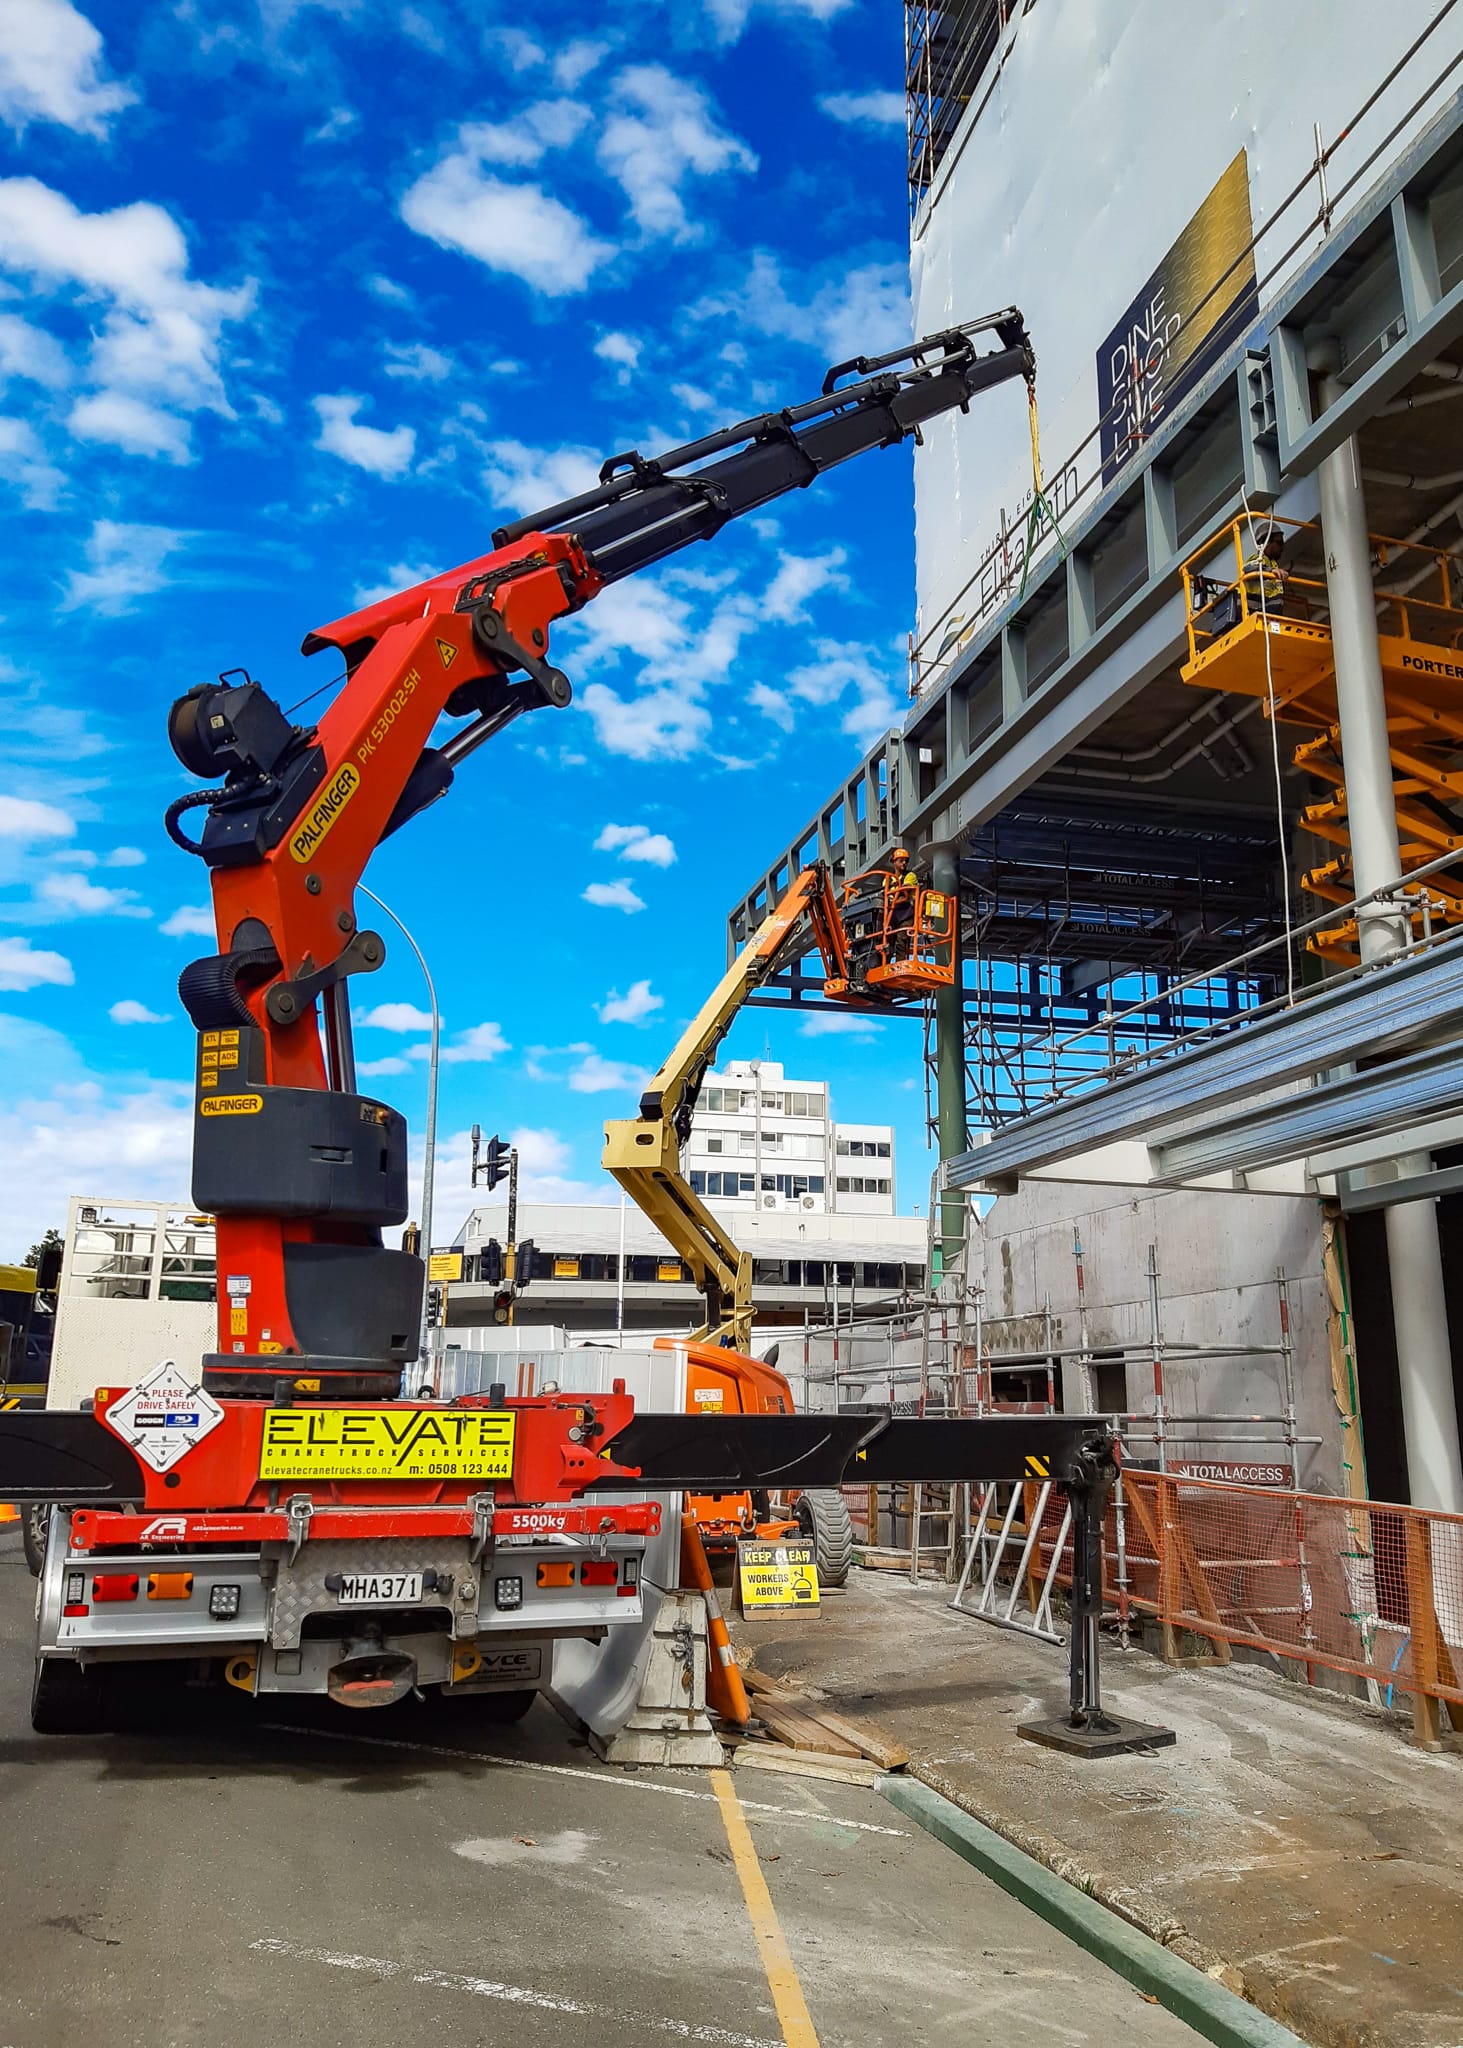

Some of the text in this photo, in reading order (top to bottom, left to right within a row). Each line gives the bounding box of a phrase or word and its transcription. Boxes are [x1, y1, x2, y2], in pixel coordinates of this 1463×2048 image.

[1111, 286, 1166, 388] DINE
[980, 514, 1013, 566] THIRY
[357, 667, 422, 764] PK 53002-SH
[293, 768, 357, 858] PALFINGER
[203, 1098, 258, 1113] PALFINGER
[151, 1389, 184, 1398] PLEASE
[137, 1401, 196, 1410] DRIVE SAFELY
[268, 1411, 511, 1460] ELEVATE
[267, 1448, 509, 1457] CRANE TRUCK SERVICES
[264, 1466, 393, 1475] elevatecranetrucks.co.nz
[409, 1464, 508, 1475] m: 0508 123 444
[1191, 1465, 1284, 1481] TOTALACCESS
[512, 1514, 566, 1530] 5500kg
[744, 1551, 772, 1563] KEEP
[747, 1574, 789, 1584] WORKERS
[340, 1577, 416, 1599] MHA371
[755, 1586, 784, 1596] ABOVE
